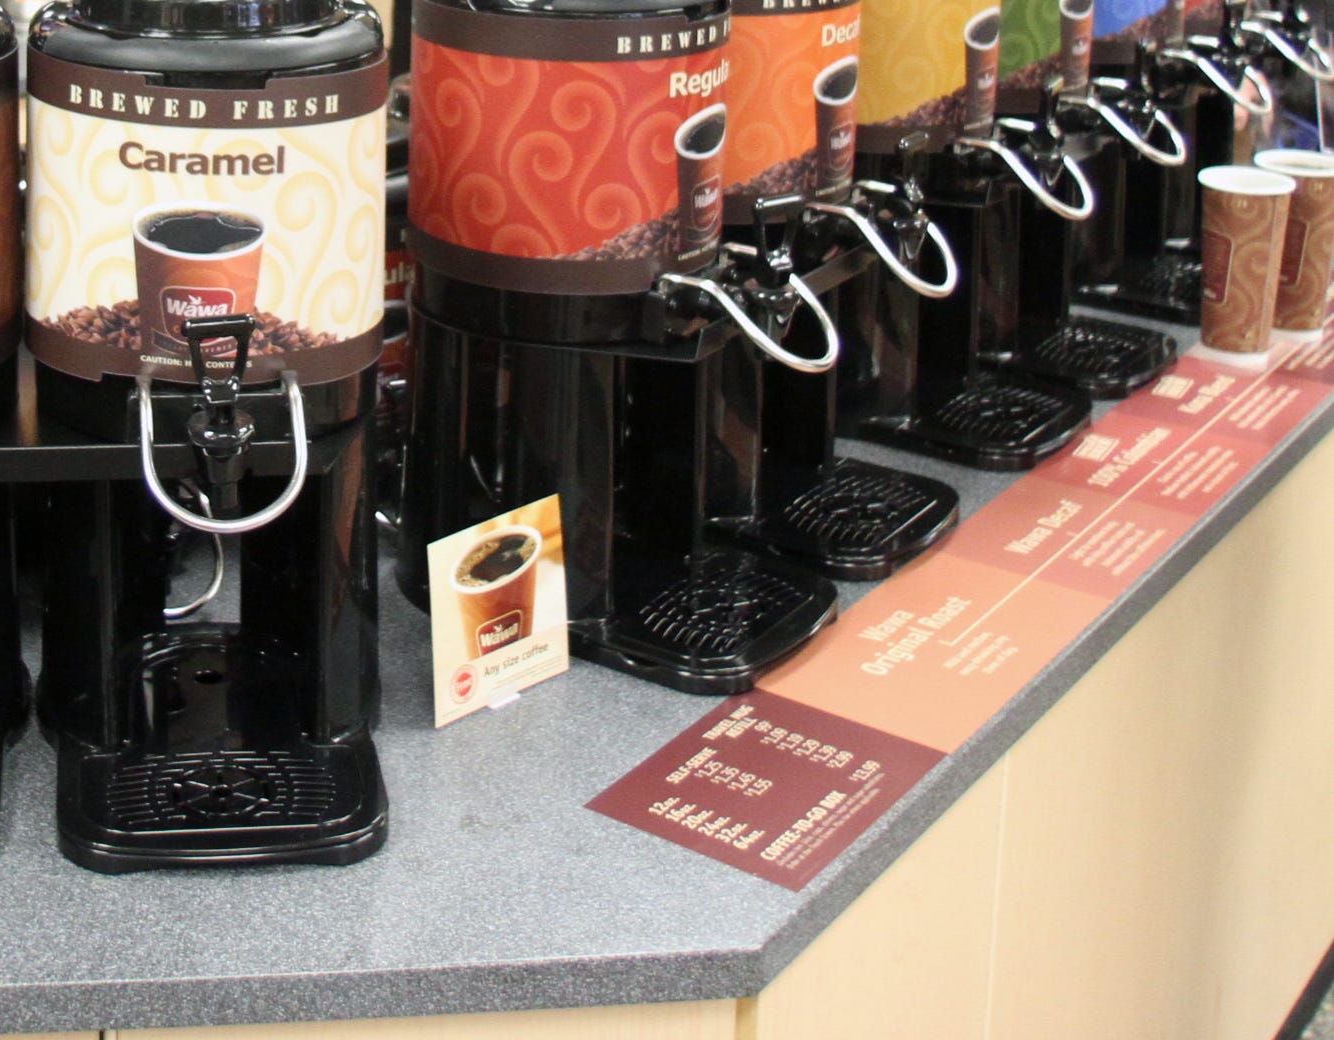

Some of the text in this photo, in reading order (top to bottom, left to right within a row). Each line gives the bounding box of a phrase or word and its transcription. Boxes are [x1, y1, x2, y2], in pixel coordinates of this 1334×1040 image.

[617, 25, 717, 54] BREWED
[69, 83, 340, 121] BREWED FRESH
[118, 141, 286, 176] Caramel
[166, 295, 229, 317] Wawa
[140, 355, 183, 367] CAUTION:
[205, 360, 253, 369] CONTES
[1037, 499, 1083, 528] Decaf
[479, 623, 519, 648] Wawa
[858, 609, 915, 642] Wawa
[860, 626, 935, 675] Original
[917, 596, 972, 630] Roast
[484, 642, 549, 679] Any size coffee
[666, 747, 717, 785] SELF-SERVE
[760, 806, 828, 860] COFFEE-TO-GO
[819, 790, 848, 809] BOX
